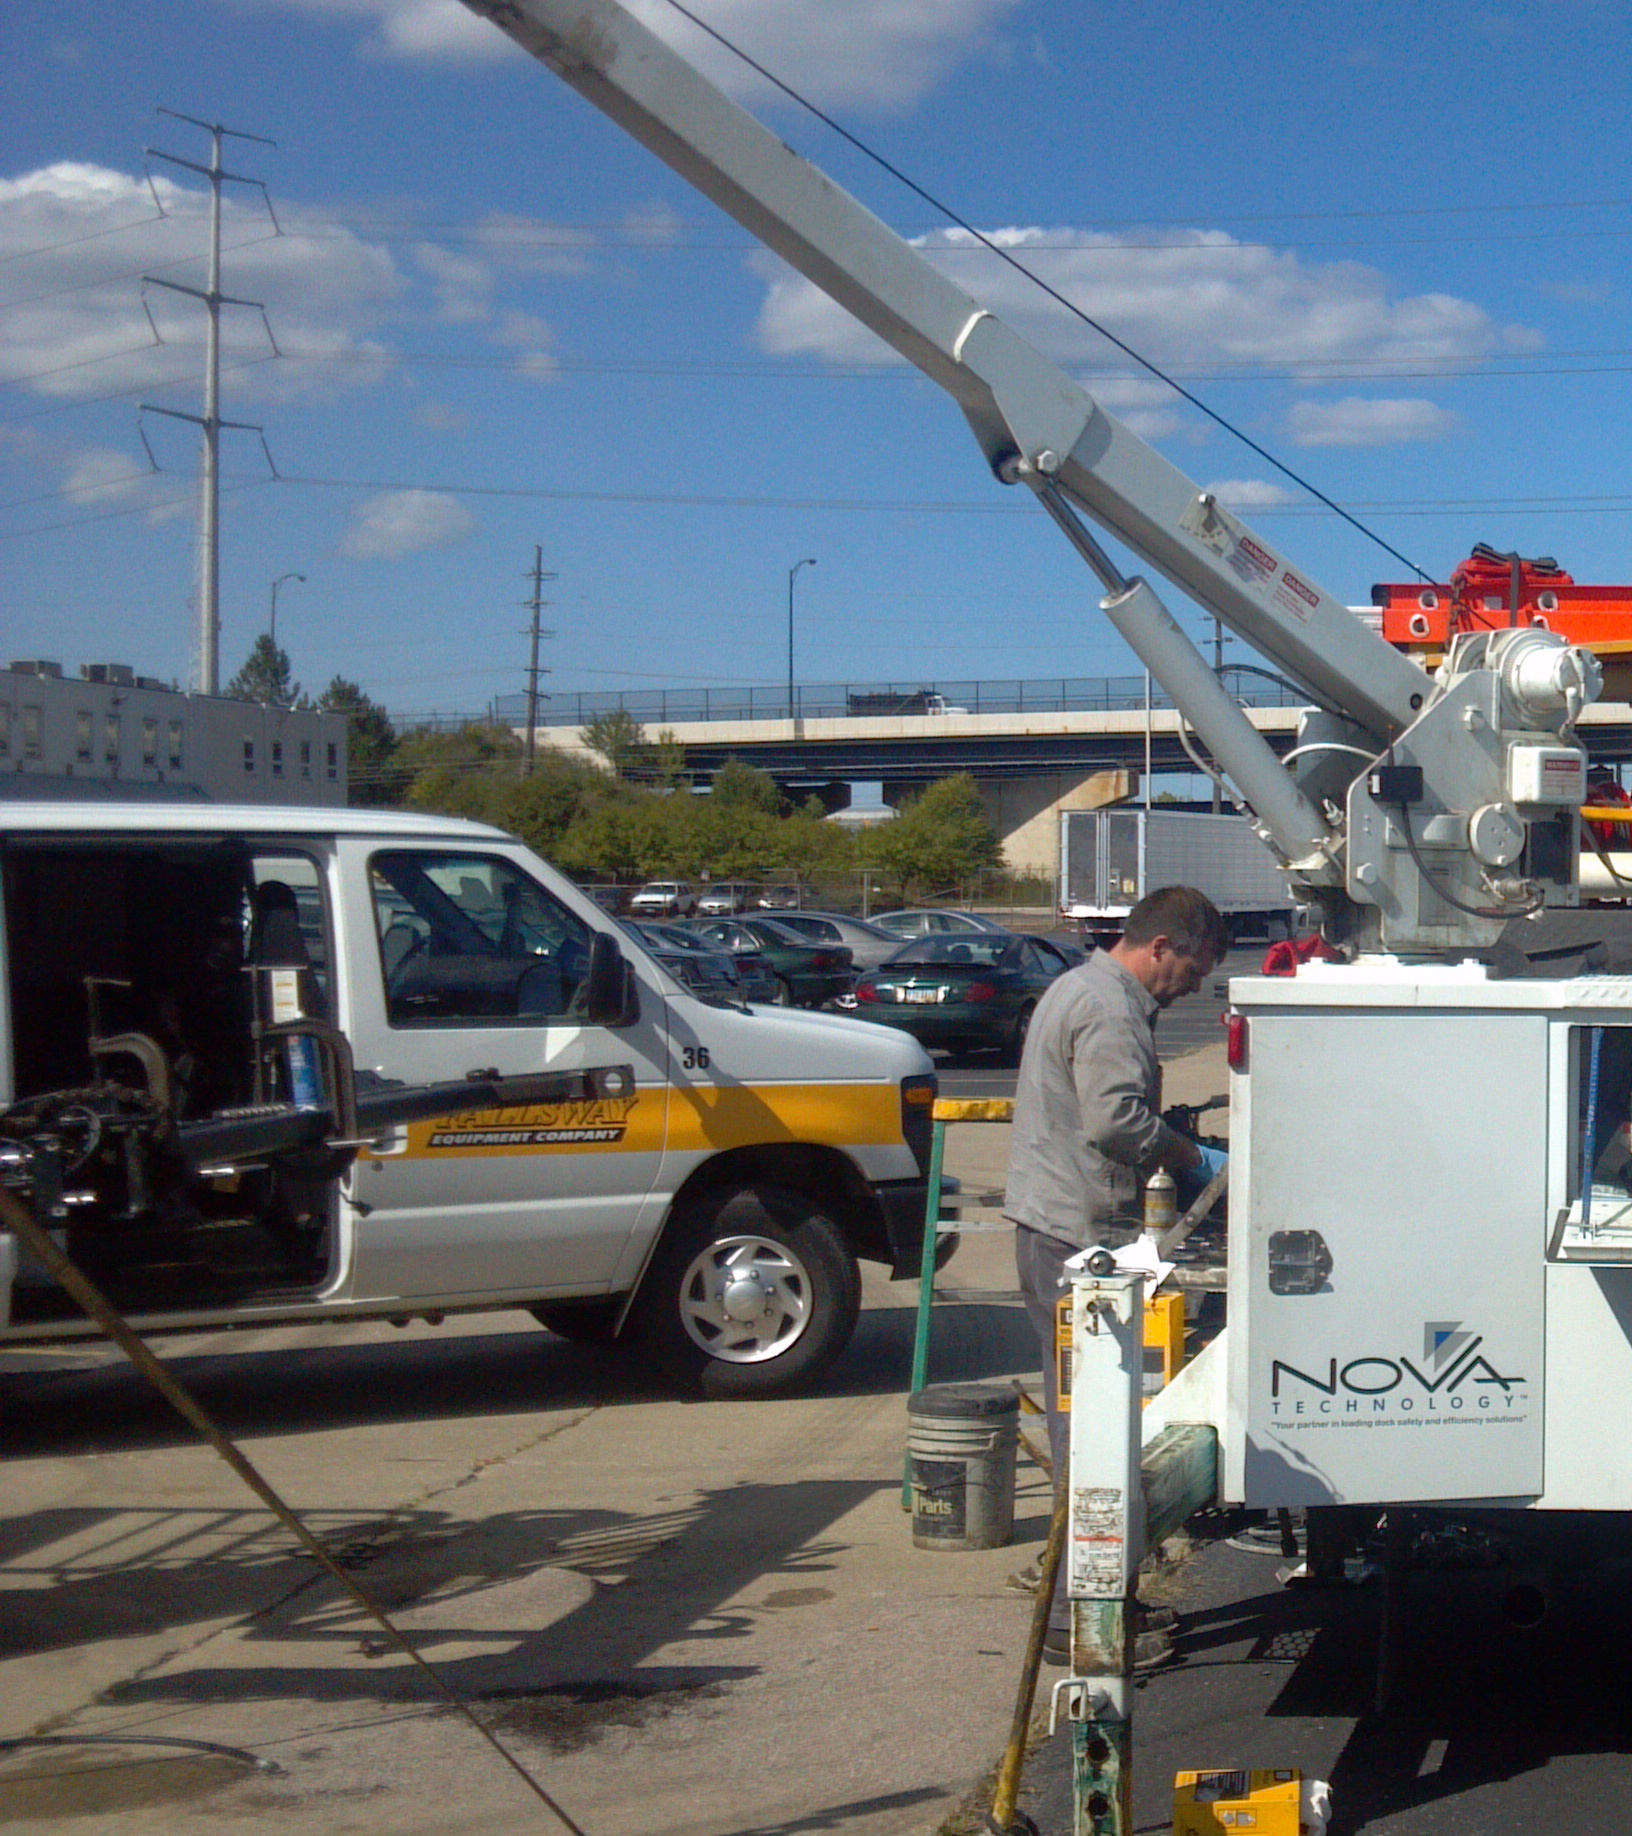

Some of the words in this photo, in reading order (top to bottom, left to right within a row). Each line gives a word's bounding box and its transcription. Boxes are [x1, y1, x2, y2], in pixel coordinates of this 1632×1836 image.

[1240, 537, 1277, 572] DANGER
[1283, 573, 1319, 607] DANGER
[683, 1047, 709, 1069] 36
[431, 1132, 532, 1145] EQUIPMENT
[535, 1129, 620, 1142] COMPANY
[1272, 1336, 1527, 1397] NOVA
[1272, 1395, 1514, 1415] TECHNOLOGY
[1297, 1420, 1330, 1430] partner
[1331, 1420, 1340, 1428] in
[1341, 1418, 1373, 1429] loading
[1374, 1418, 1396, 1427] dock
[1397, 1416, 1423, 1427] safety
[1424, 1417, 1441, 1425] and
[1443, 1416, 1484, 1426] efficiency
